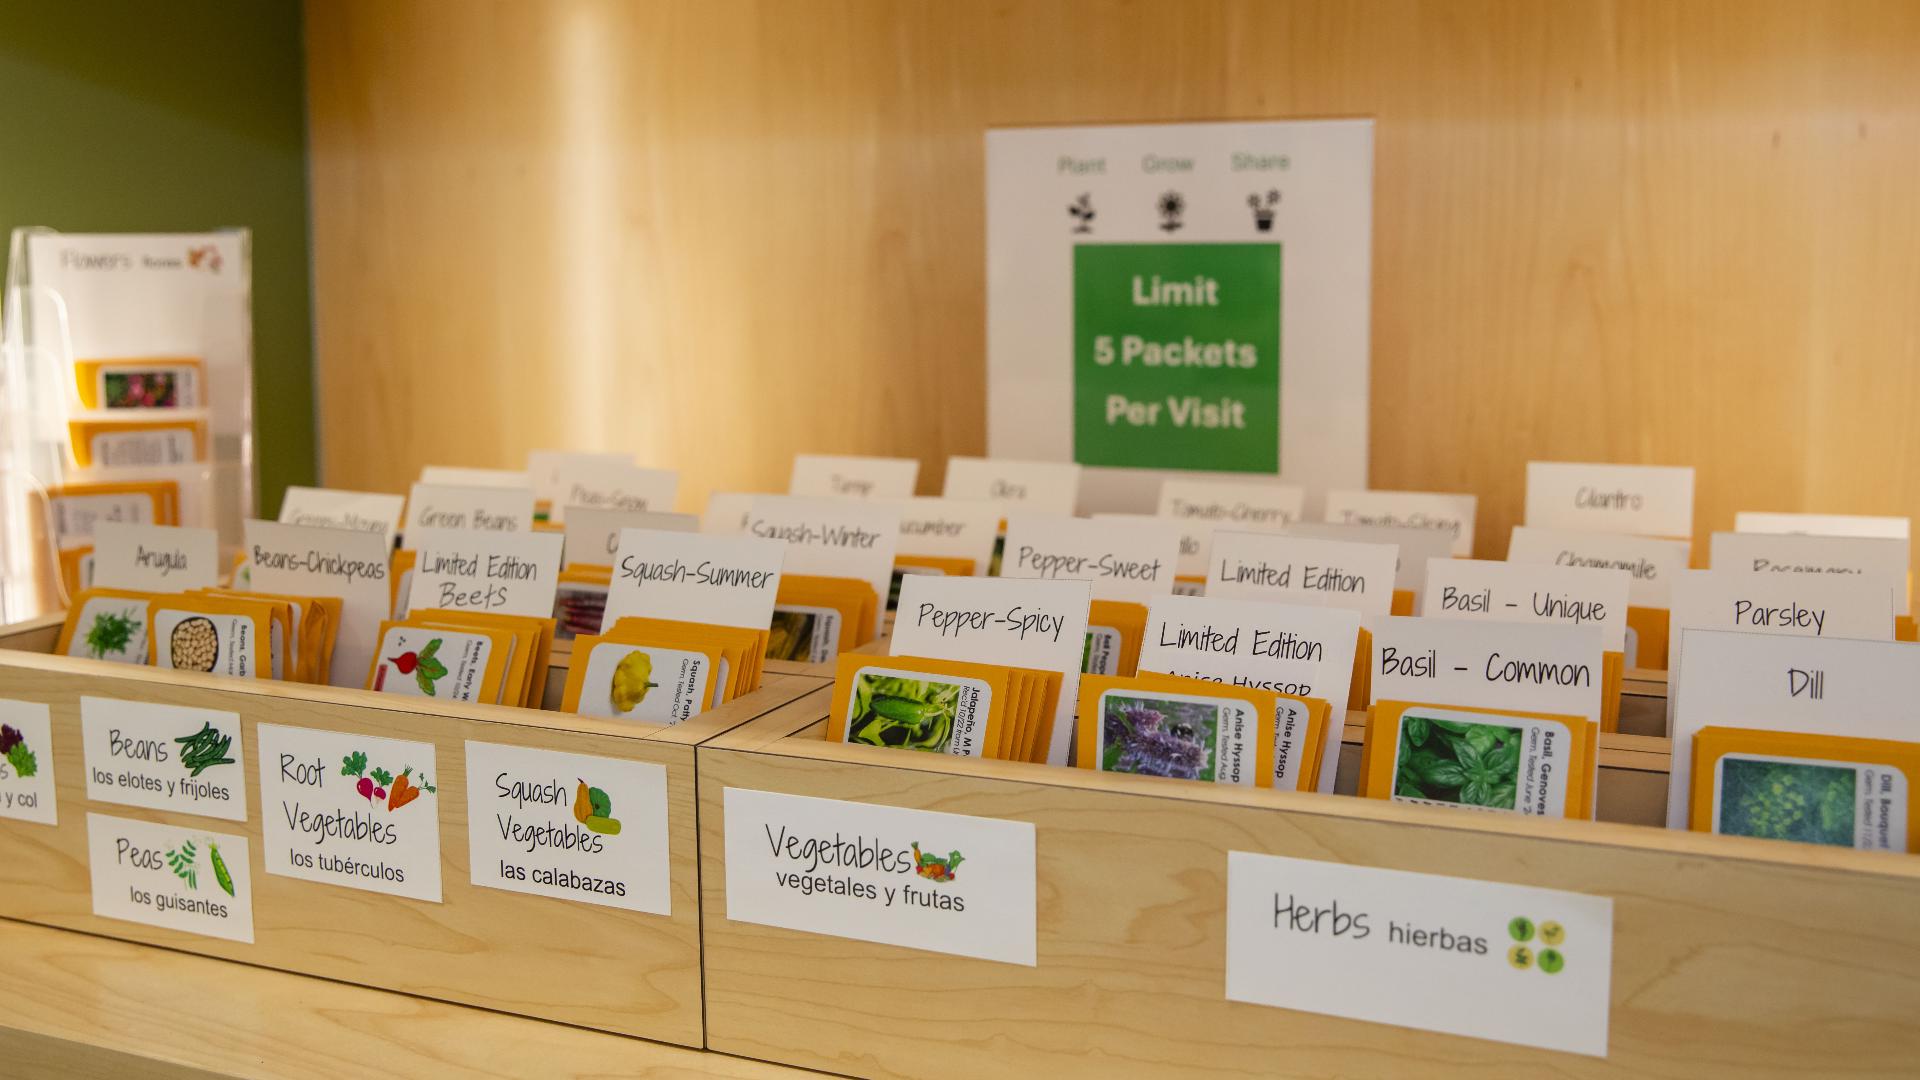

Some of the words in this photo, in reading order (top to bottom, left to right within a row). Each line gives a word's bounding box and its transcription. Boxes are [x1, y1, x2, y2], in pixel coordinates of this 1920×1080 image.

[1142, 154, 1195, 173] Grow
[1231, 153, 1290, 172] Share
[1133, 276, 1219, 306] Limit
[1094, 336, 1114, 366] 5
[1122, 336, 1258, 368] Packets
[1106, 395, 1160, 426] Per
[1167, 396, 1246, 429] Visit
[418, 506, 466, 530] Green
[473, 508, 518, 533] Beans
[135, 545, 188, 577] Arugula
[254, 545, 385, 584] Beans-Chickpeas
[422, 551, 479, 578] Limited
[487, 554, 537, 581] Edition
[620, 555, 774, 589] Squash-Summer
[1018, 546, 1161, 581] Pepper-Sweet
[1220, 559, 1291, 588] Limited
[1303, 566, 1366, 593] Edition
[438, 581, 508, 609] Beets
[1442, 587, 1490, 613] Basil
[1533, 592, 1607, 625] Unique
[918, 603, 1065, 642] Pepper-Spicy
[1735, 600, 1825, 636] Parsley
[1160, 622, 1240, 656] Limited
[1252, 629, 1322, 662] Edition
[686, 659, 701, 696] Squash,
[1381, 648, 1436, 678] Basil
[1486, 653, 1590, 687] Common
[1787, 668, 1824, 700] Dill
[964, 687, 980, 735] Jalapeño,
[1235, 708, 1245, 740] Anise
[1284, 708, 1297, 738] Anise
[109, 729, 169, 763] Beans
[1231, 743, 1243, 783] Hyssop
[1275, 741, 1292, 778] Hyssop
[92, 767, 114, 787] los
[118, 769, 163, 792] elotes
[167, 779, 176, 797] y
[180, 778, 230, 801] frijoles
[280, 753, 326, 788] Root
[5, 791, 14, 808] y
[17, 791, 38, 808] col
[495, 772, 567, 808] Squash
[283, 800, 398, 845] Vegetables
[497, 813, 604, 854] Vegetables
[116, 837, 164, 871] Peas
[290, 848, 314, 869] los
[318, 852, 405, 884] tubérculos
[765, 823, 911, 874] Vegetables
[499, 859, 527, 882] las
[531, 865, 626, 897] calabazas
[776, 871, 877, 900] vegetales
[884, 886, 896, 907] y
[902, 885, 965, 912] frutas
[130, 886, 152, 905] los
[156, 890, 228, 918] guisantes
[1273, 892, 1371, 940] Herbs
[1388, 921, 1488, 956] hierbas
